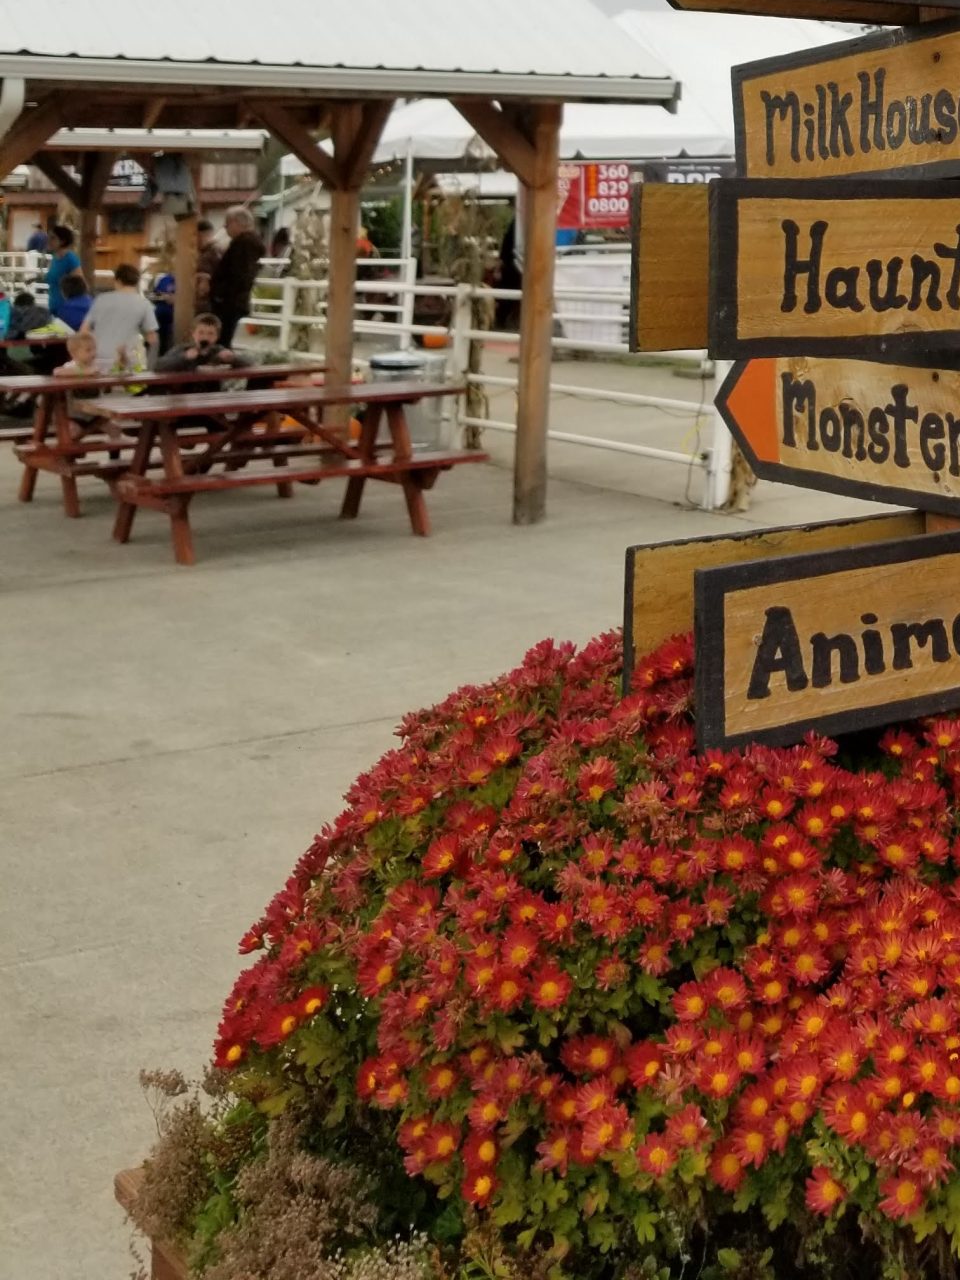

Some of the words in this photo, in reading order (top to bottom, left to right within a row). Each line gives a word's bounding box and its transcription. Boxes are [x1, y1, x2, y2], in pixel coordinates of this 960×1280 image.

[598, 164, 629, 179] 360
[598, 180, 629, 195] 829
[588, 197, 630, 212] 0800
